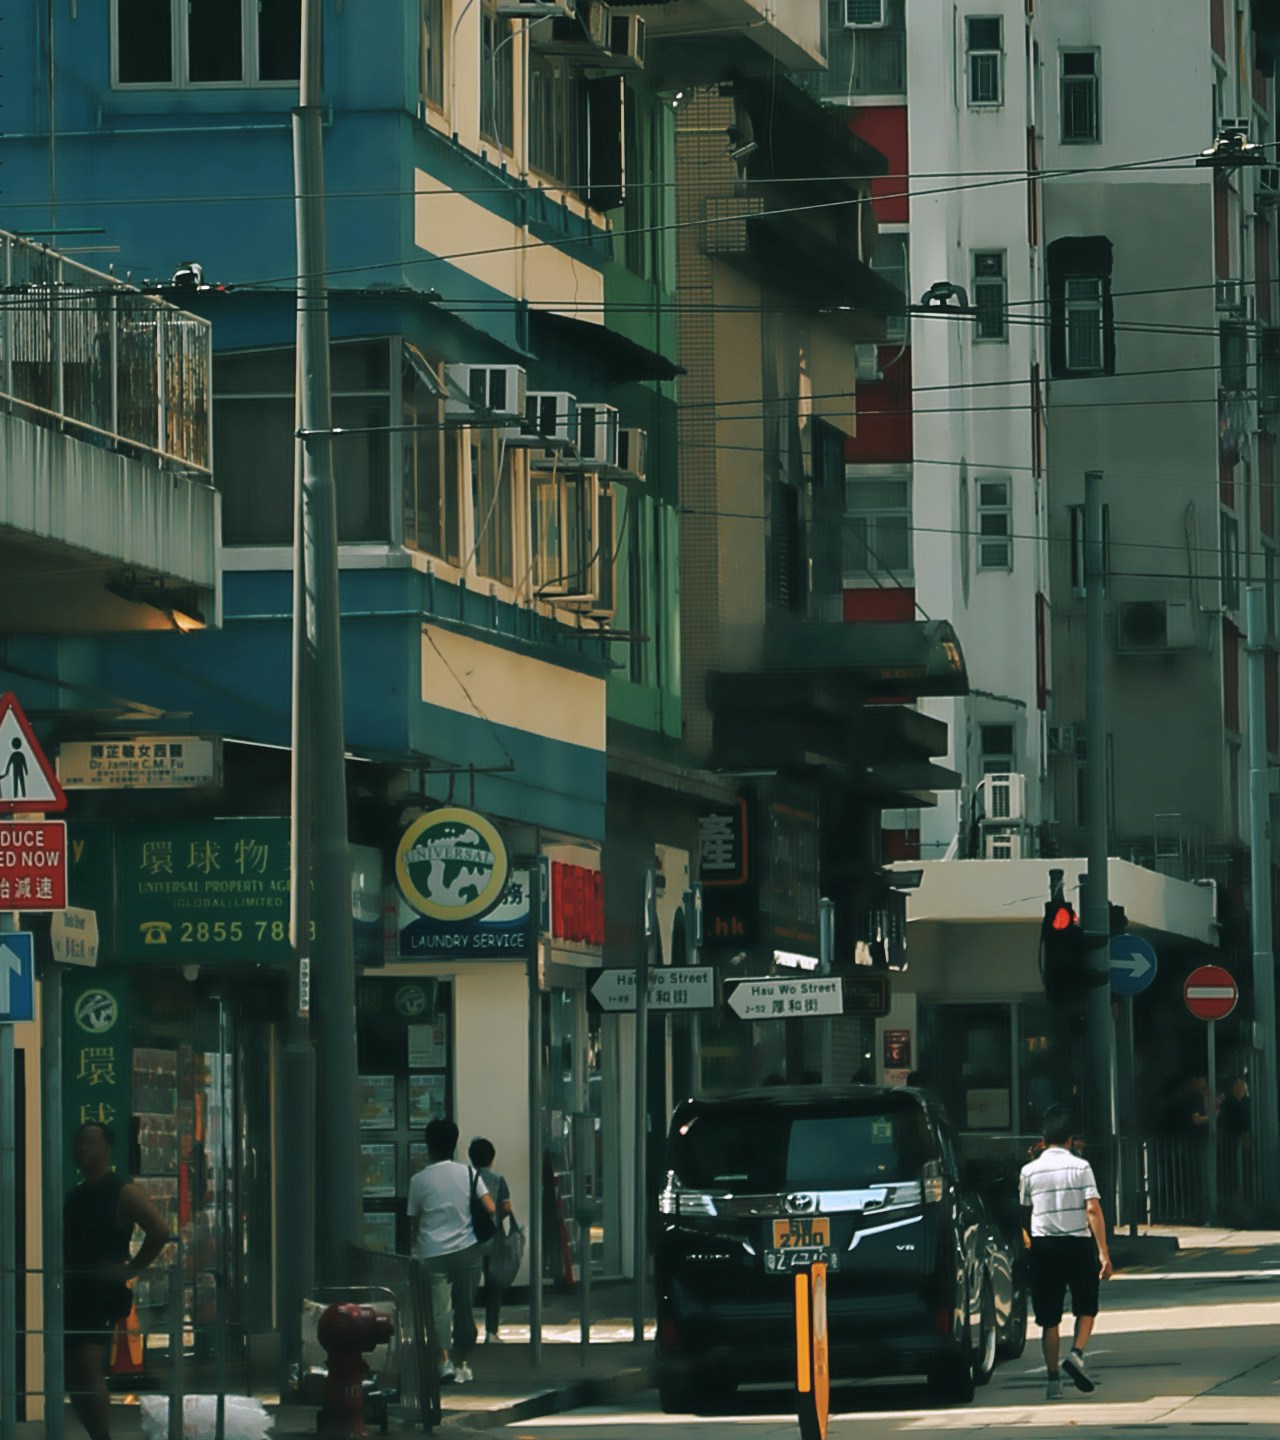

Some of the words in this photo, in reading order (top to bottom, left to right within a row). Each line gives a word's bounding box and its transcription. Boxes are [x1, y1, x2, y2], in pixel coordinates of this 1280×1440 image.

[89, 760, 105, 769] Dr.
[107, 759, 138, 770] Jamie
[170, 758, 184, 769] Fu
[21, 851, 59, 867] NOW
[139, 839, 292, 875] 環球物
[404, 846, 495, 863] UNIVERSAL
[138, 880, 199, 894] UNIVERSAL
[205, 879, 264, 893] PROPERTY
[235, 897, 283, 907] LIMITED
[180, 921, 242, 942] 2855
[411, 933, 468, 949] LAUNDRY
[472, 932, 524, 949] SERVICE
[670, 972, 708, 984] Street
[751, 985, 774, 996] Hau
[778, 984, 797, 995] Wo
[801, 983, 836, 994] Street
